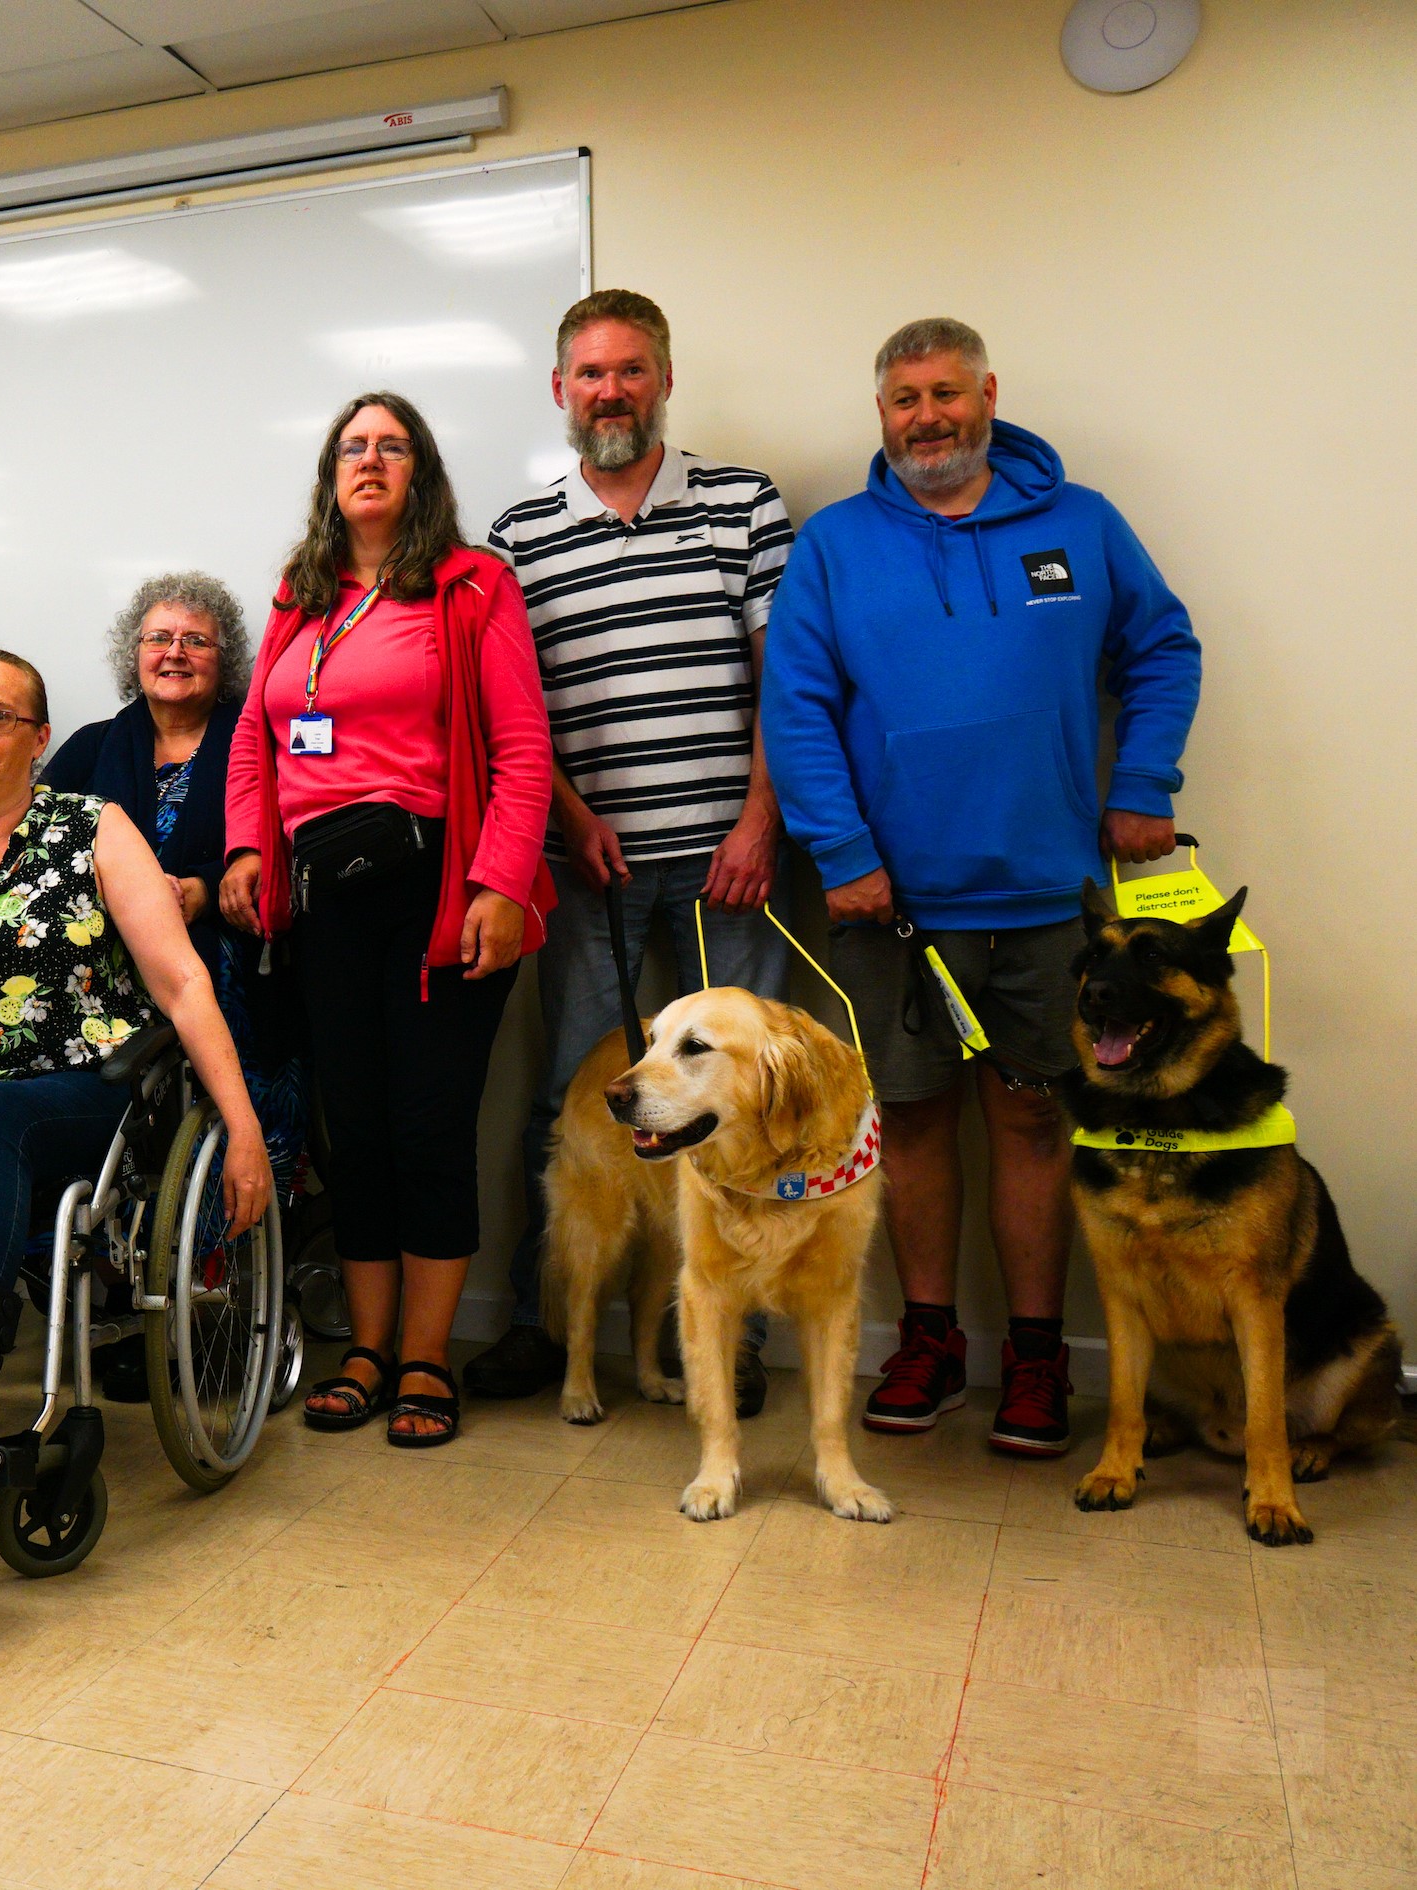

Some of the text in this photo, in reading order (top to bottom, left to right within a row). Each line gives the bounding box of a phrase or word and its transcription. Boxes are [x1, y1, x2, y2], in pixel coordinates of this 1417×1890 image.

[389, 115, 413, 127] ABIS
[1135, 886, 1200, 902] Please don't
[1136, 902, 1178, 912] distract
[1180, 899, 1196, 907] me
[1144, 1138, 1179, 1152] Dogs
